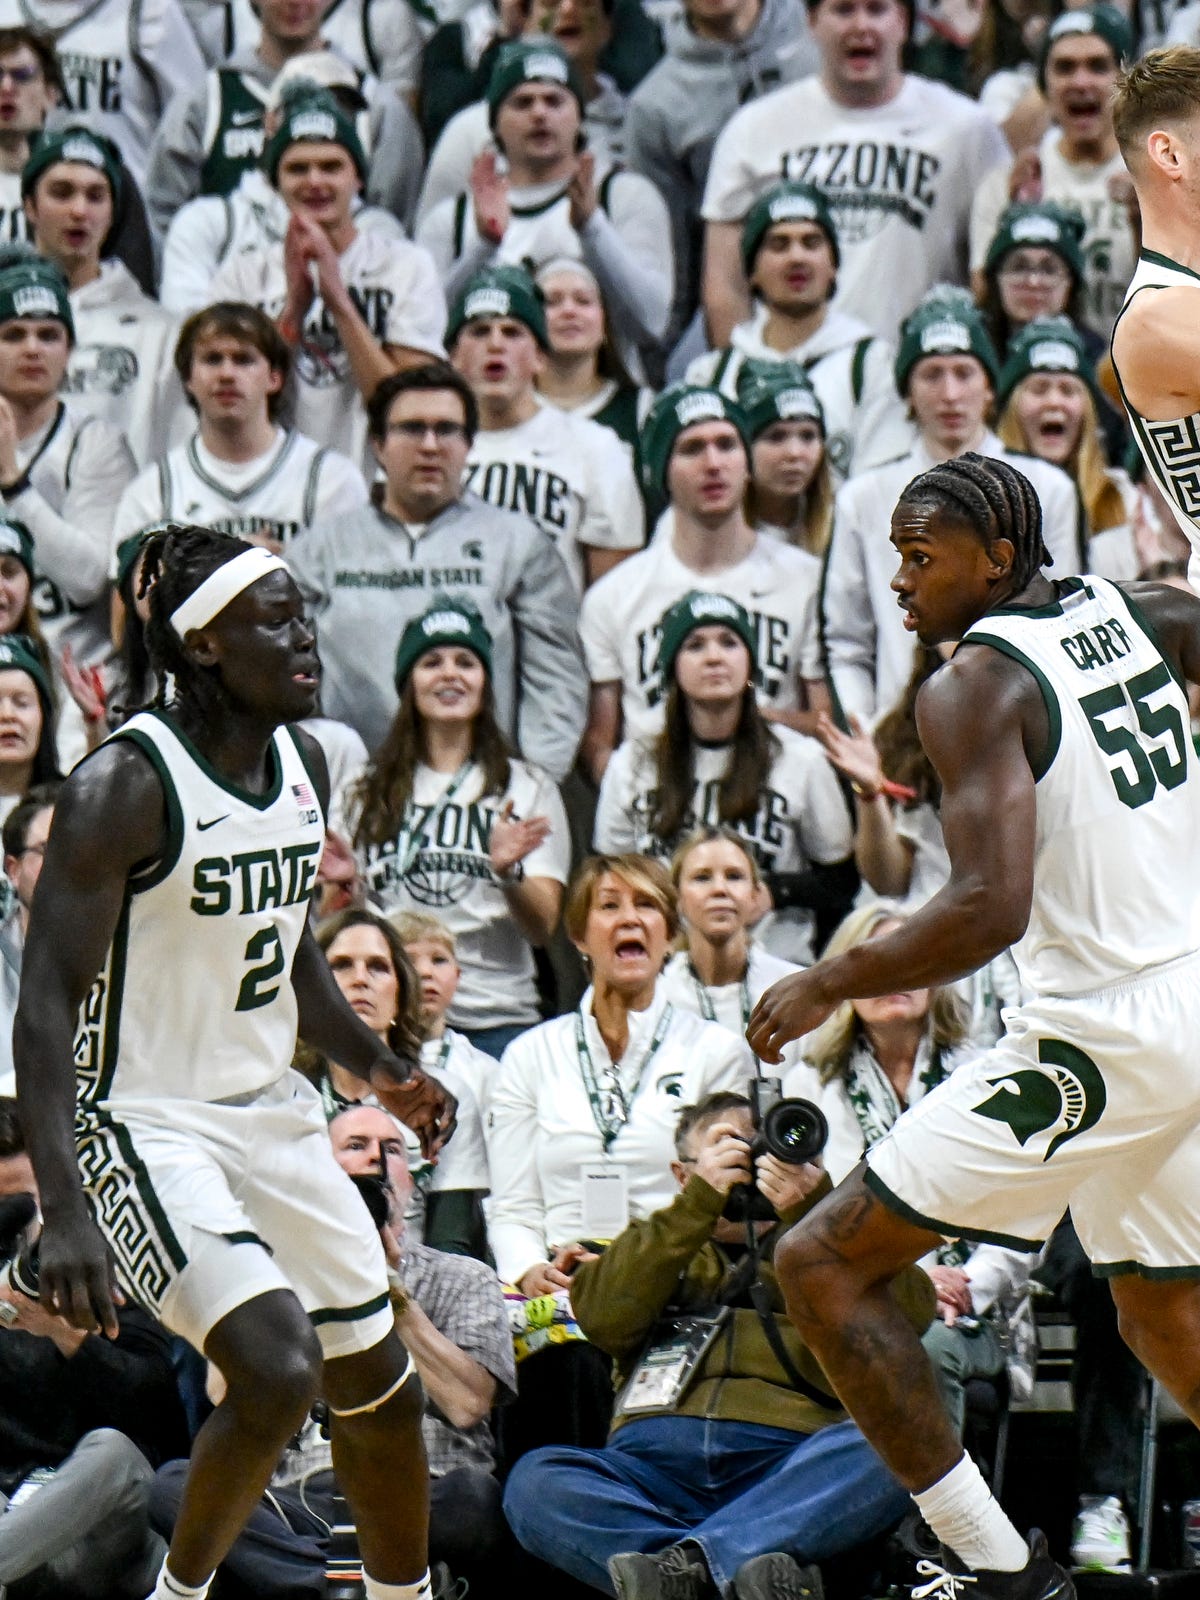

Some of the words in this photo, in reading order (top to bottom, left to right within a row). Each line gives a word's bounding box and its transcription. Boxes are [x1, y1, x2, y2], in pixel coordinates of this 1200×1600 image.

[780, 141, 940, 208] IZZONE
[461, 462, 568, 529] ZONE
[335, 569, 424, 589] MICHIGAN
[430, 567, 482, 587] STATE
[1060, 617, 1132, 671] CARR
[1078, 661, 1188, 810] 55
[190, 841, 320, 916] STATE
[234, 924, 285, 1012] 2
